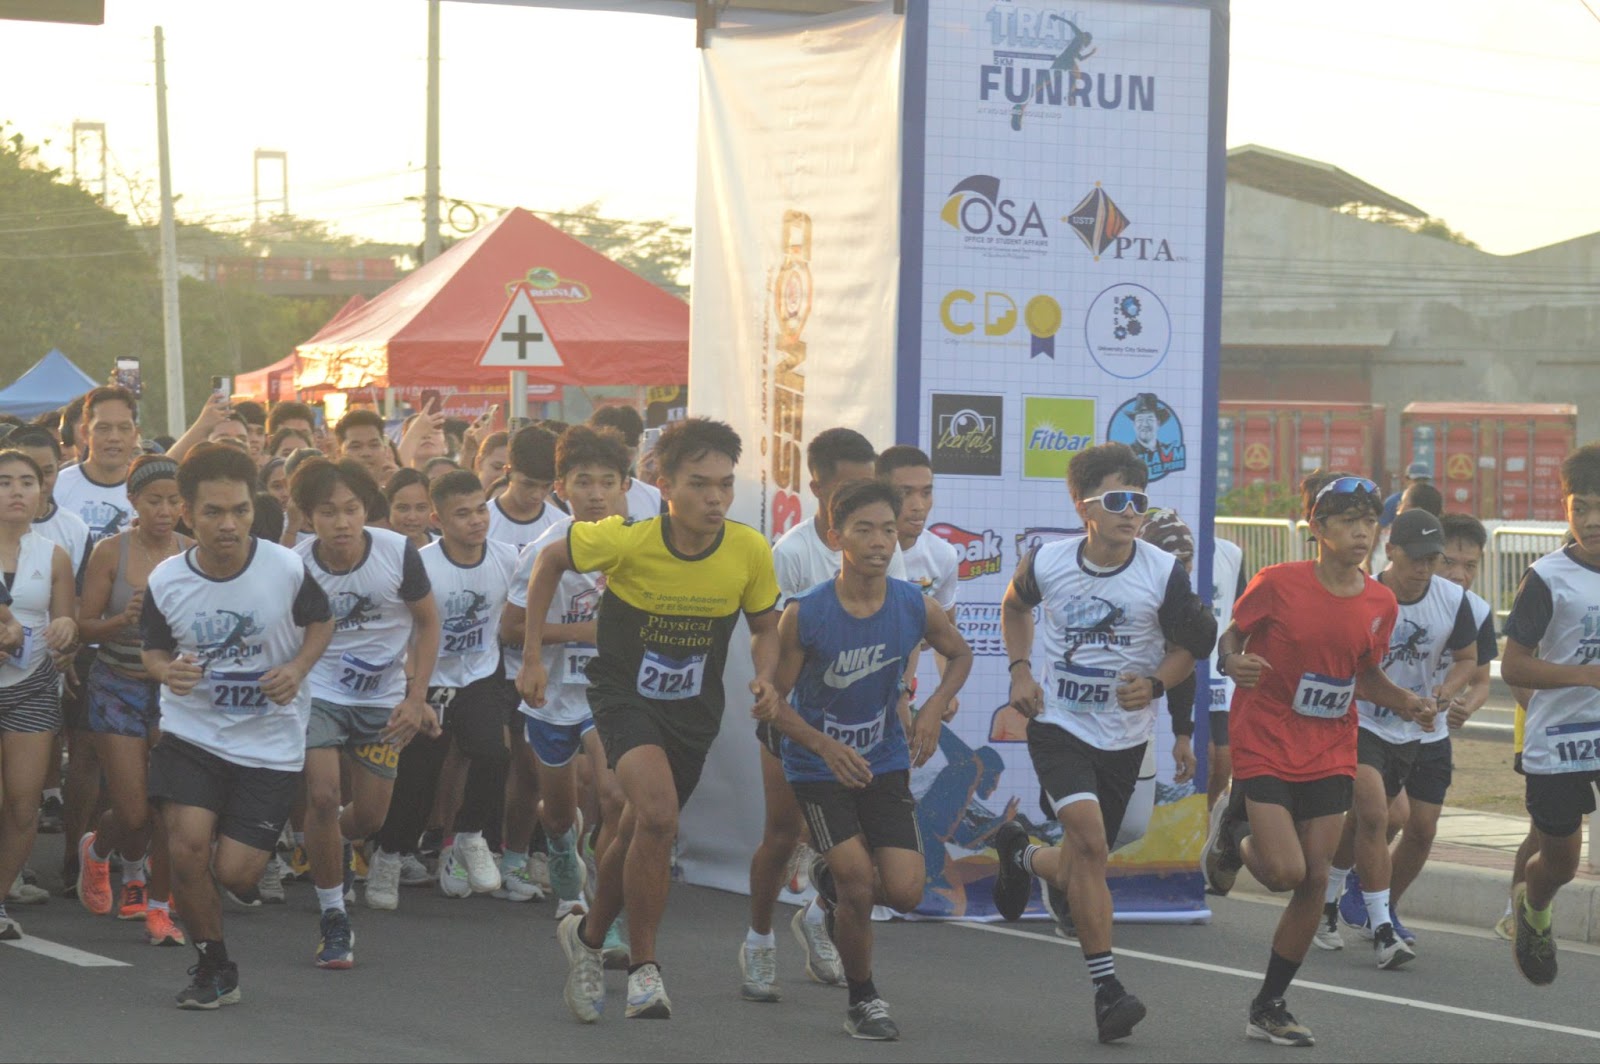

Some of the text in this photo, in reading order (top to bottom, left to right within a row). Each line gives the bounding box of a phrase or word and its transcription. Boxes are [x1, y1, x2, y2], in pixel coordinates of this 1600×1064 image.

[980, 64, 1155, 112] FUNRUN
[961, 197, 1048, 238] OSA
[1113, 236, 1175, 262] PTA
[1029, 429, 1092, 451] Fitbar
[648, 615, 714, 632] Physical
[443, 627, 484, 652] 2261
[834, 643, 887, 673] NIKE
[641, 666, 695, 693] 2124
[1057, 678, 1110, 703] 1025
[1301, 687, 1350, 710] 1142
